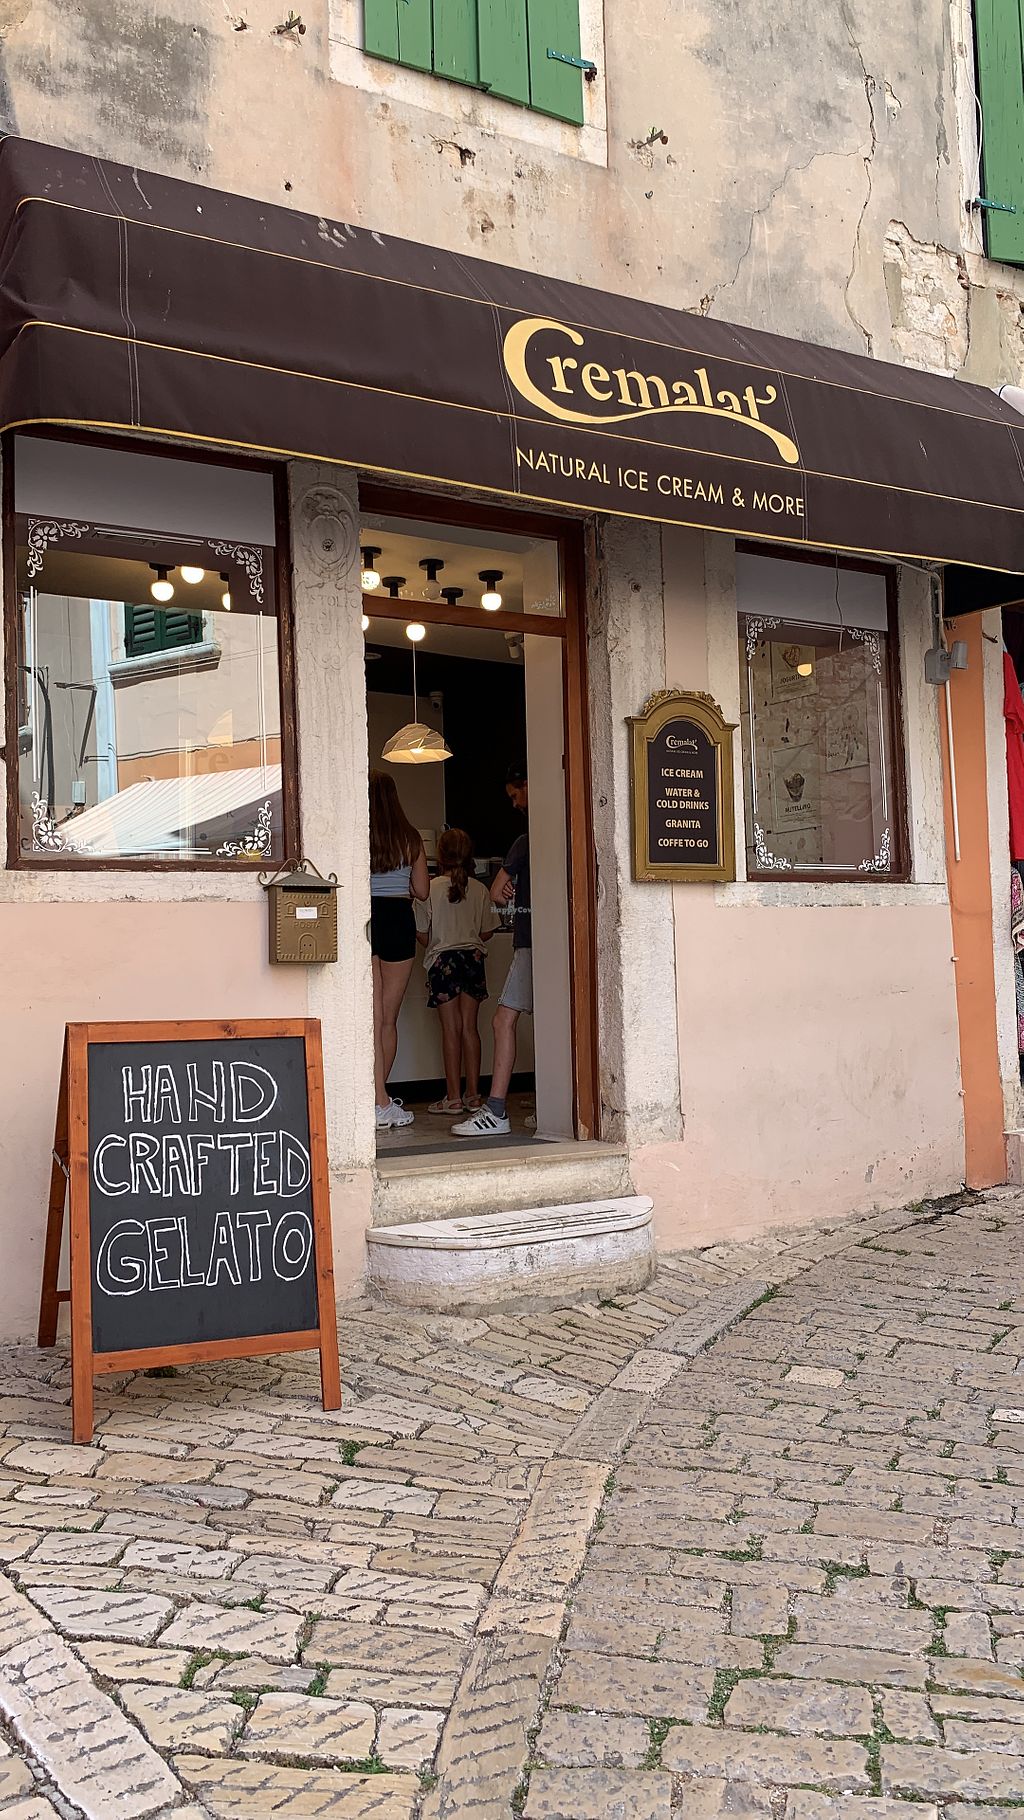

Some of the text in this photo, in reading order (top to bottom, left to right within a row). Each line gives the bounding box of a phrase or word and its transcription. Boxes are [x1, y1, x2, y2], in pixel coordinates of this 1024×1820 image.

[503, 318, 800, 464] Cremalat
[515, 446, 805, 517] NATURAL ICE CREAM & MORE
[661, 767, 704, 779] ICE CREAM
[656, 799, 710, 810] COLD DRINKS
[665, 787, 701, 798] WATER &
[658, 838, 709, 848] COFFE TO GO
[665, 819, 701, 829] GRANITA
[121, 1060, 279, 1124] HAND
[93, 1130, 312, 1198] CRAFTED
[96, 1210, 313, 1296] GELATO
